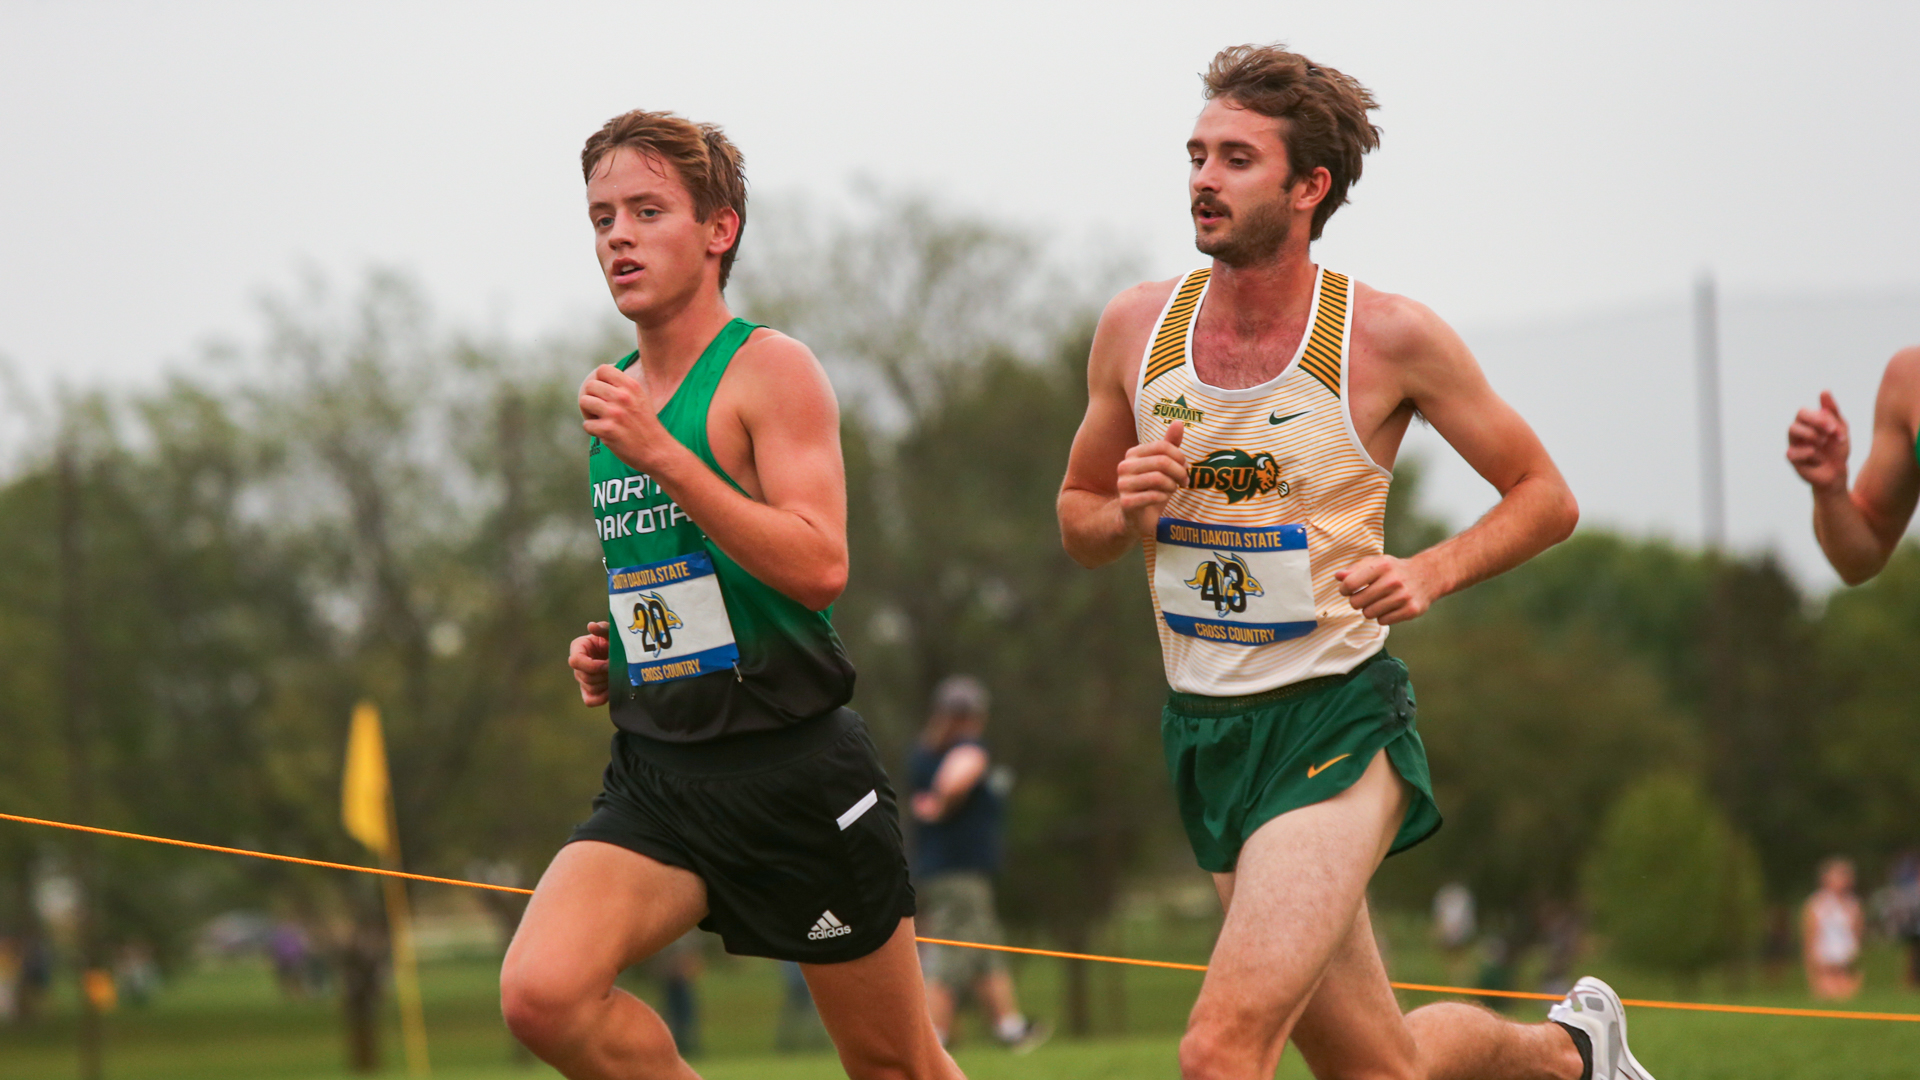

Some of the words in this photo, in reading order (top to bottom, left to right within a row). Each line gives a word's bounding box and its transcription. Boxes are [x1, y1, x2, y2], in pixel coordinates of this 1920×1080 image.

[1153, 404, 1204, 422] SUMMIT
[1163, 418, 1192, 428] LEUE
[593, 474, 662, 511] NORT
[1170, 525, 1199, 543] SOUTH
[1201, 529, 1242, 547] DAKOTA
[1244, 532, 1282, 548] STATE
[627, 569, 658, 588] DAKOTA
[656, 561, 690, 582] STATE
[1201, 561, 1247, 613] 43
[633, 600, 672, 652] 20
[1195, 623, 1227, 639] CROSS
[1228, 626, 1275, 643] COUNTRY
[641, 667, 664, 682] CROSS
[662, 659, 701, 678] COUNTRY
[807, 925, 851, 940] adidas
